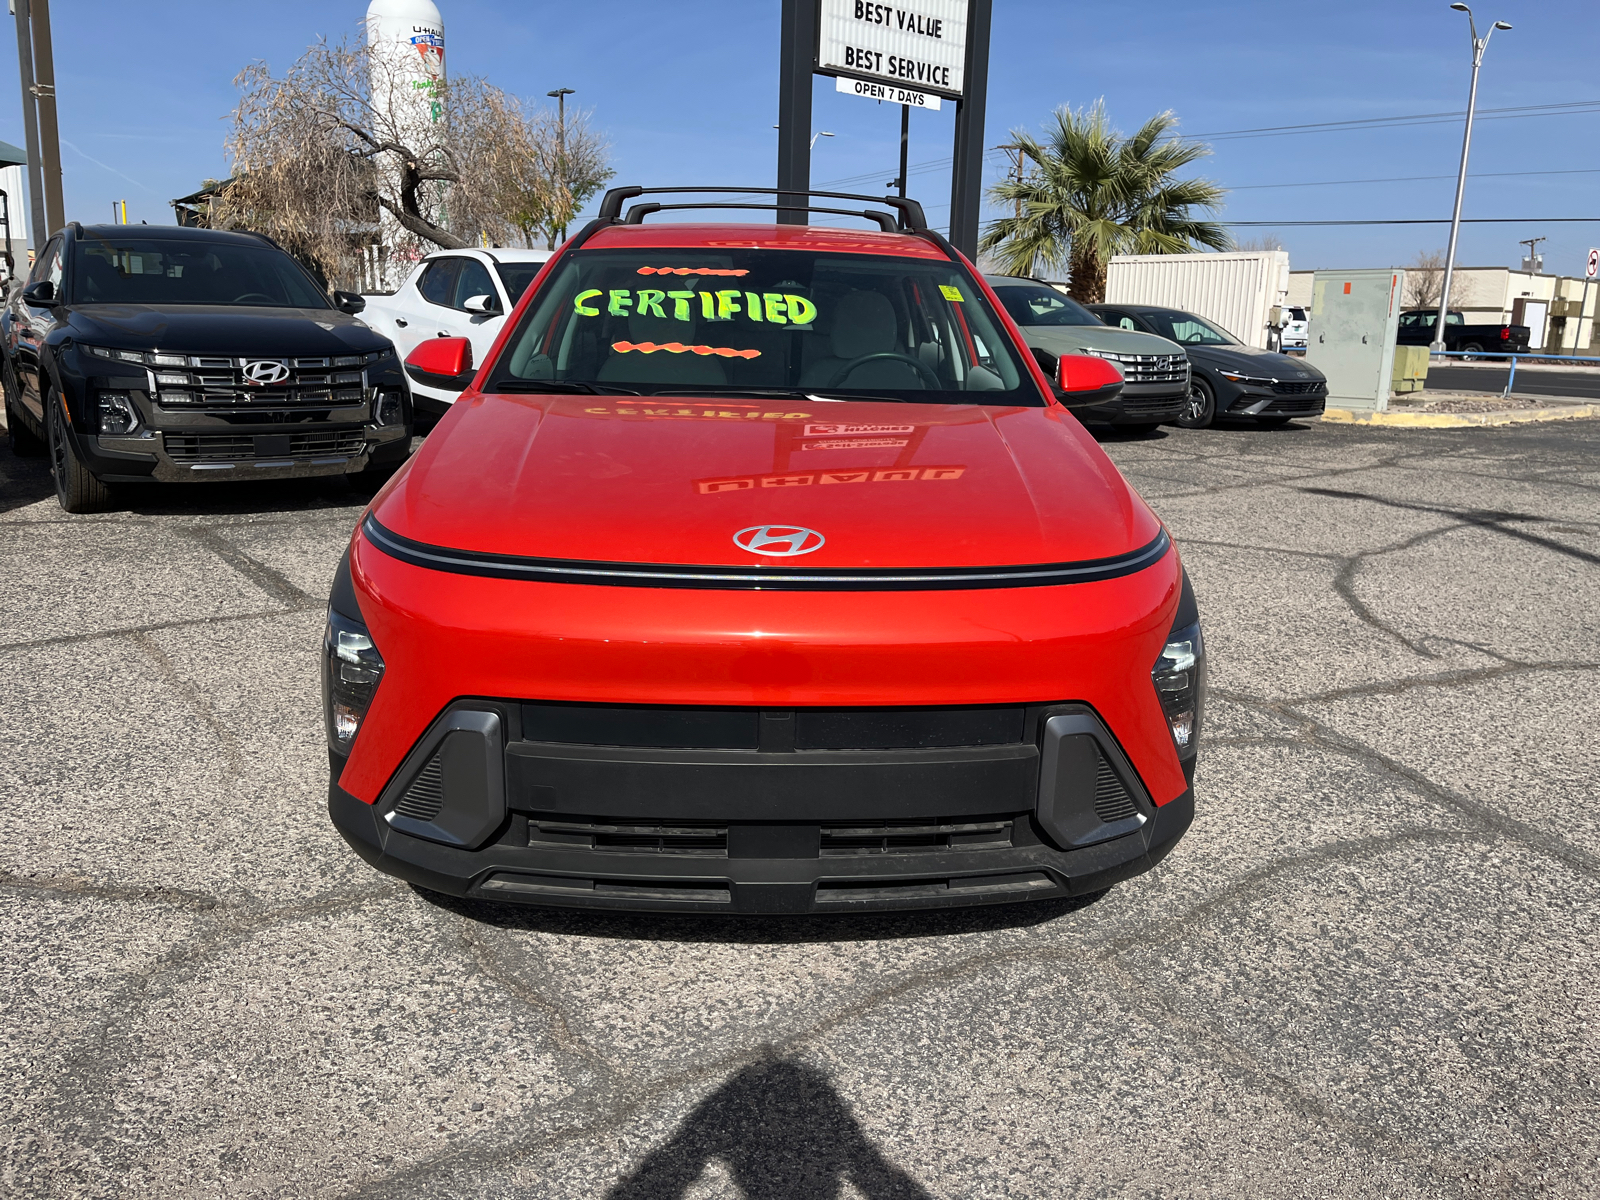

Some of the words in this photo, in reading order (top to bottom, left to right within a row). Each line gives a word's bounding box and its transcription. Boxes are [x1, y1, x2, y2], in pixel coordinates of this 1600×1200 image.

[854, 0, 892, 27] BEST
[896, 10, 942, 39] VALUE
[845, 46, 882, 72] BEST
[888, 55, 950, 86] SERVICE
[854, 82, 885, 98] OPEN
[888, 88, 895, 100] 7
[898, 90, 925, 106] DAYS
[574, 289, 818, 325] CERTIFIED
